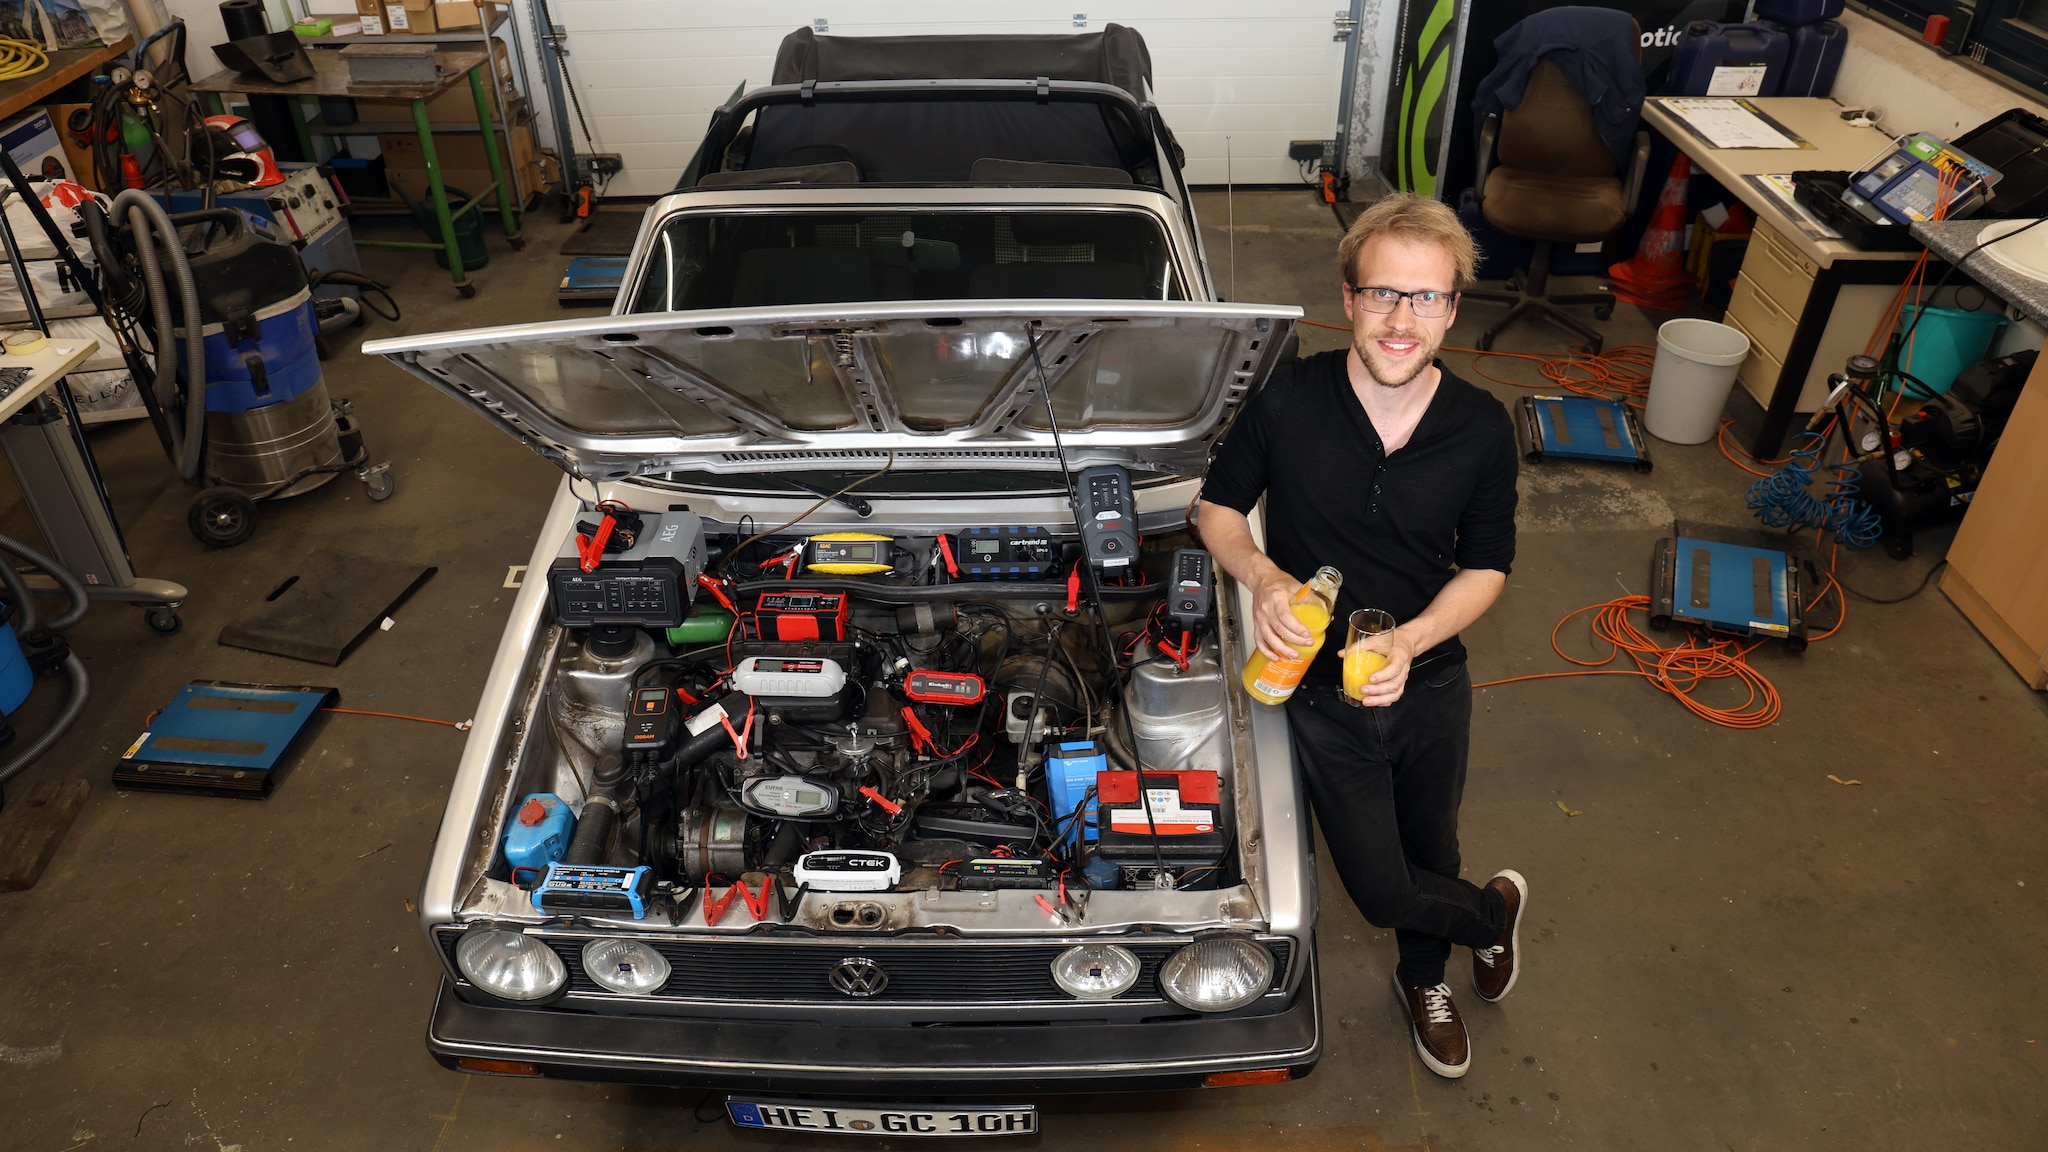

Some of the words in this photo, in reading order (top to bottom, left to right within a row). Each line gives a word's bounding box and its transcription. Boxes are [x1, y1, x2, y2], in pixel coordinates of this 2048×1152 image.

[659, 524, 679, 543] AEG
[1009, 538, 1041, 546] cartrend
[848, 859, 885, 867] CTEK
[831, 961, 885, 994] VW
[757, 1105, 844, 1129] HEI
[880, 1112, 937, 1133] GC
[948, 1112, 1032, 1132] 10H
